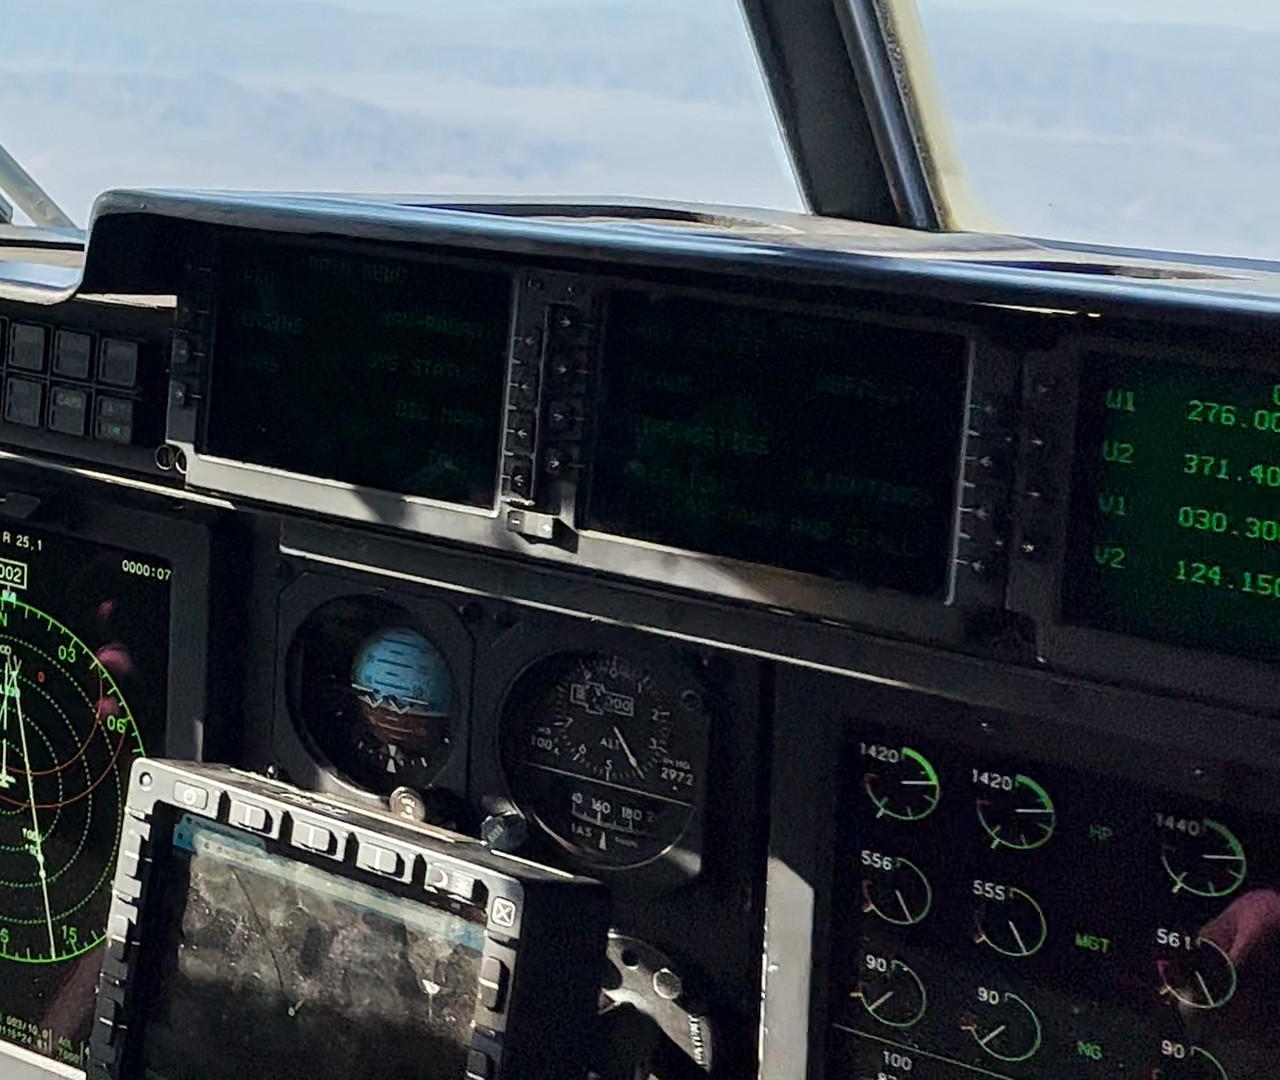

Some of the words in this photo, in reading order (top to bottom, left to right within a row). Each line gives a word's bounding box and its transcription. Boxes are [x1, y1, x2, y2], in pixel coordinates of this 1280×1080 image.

[1103, 439, 1135, 464] U2
[1177, 506, 1280, 542] 030.30
[2, 531, 11, 544] R
[121, 558, 172, 582] 0000:07
[57, 645, 77, 664] 03
[105, 715, 127, 734] 06
[860, 742, 900, 764] 1420
[971, 768, 1014, 792] 1420
[591, 798, 611, 815] 160
[621, 805, 643, 822] 180
[571, 822, 593, 838] IAS
[1156, 812, 1201, 838] 1440
[860, 849, 893, 871] 556
[972, 879, 1007, 902] 555
[61, 924, 79, 941] 15
[1156, 928, 1194, 951] 561
[864, 954, 888, 974] 90
[976, 986, 1001, 1006] 90
[883, 1048, 913, 1072] 100
[1077, 1040, 1103, 1061] NG
[1160, 1039, 1187, 1061] 90
